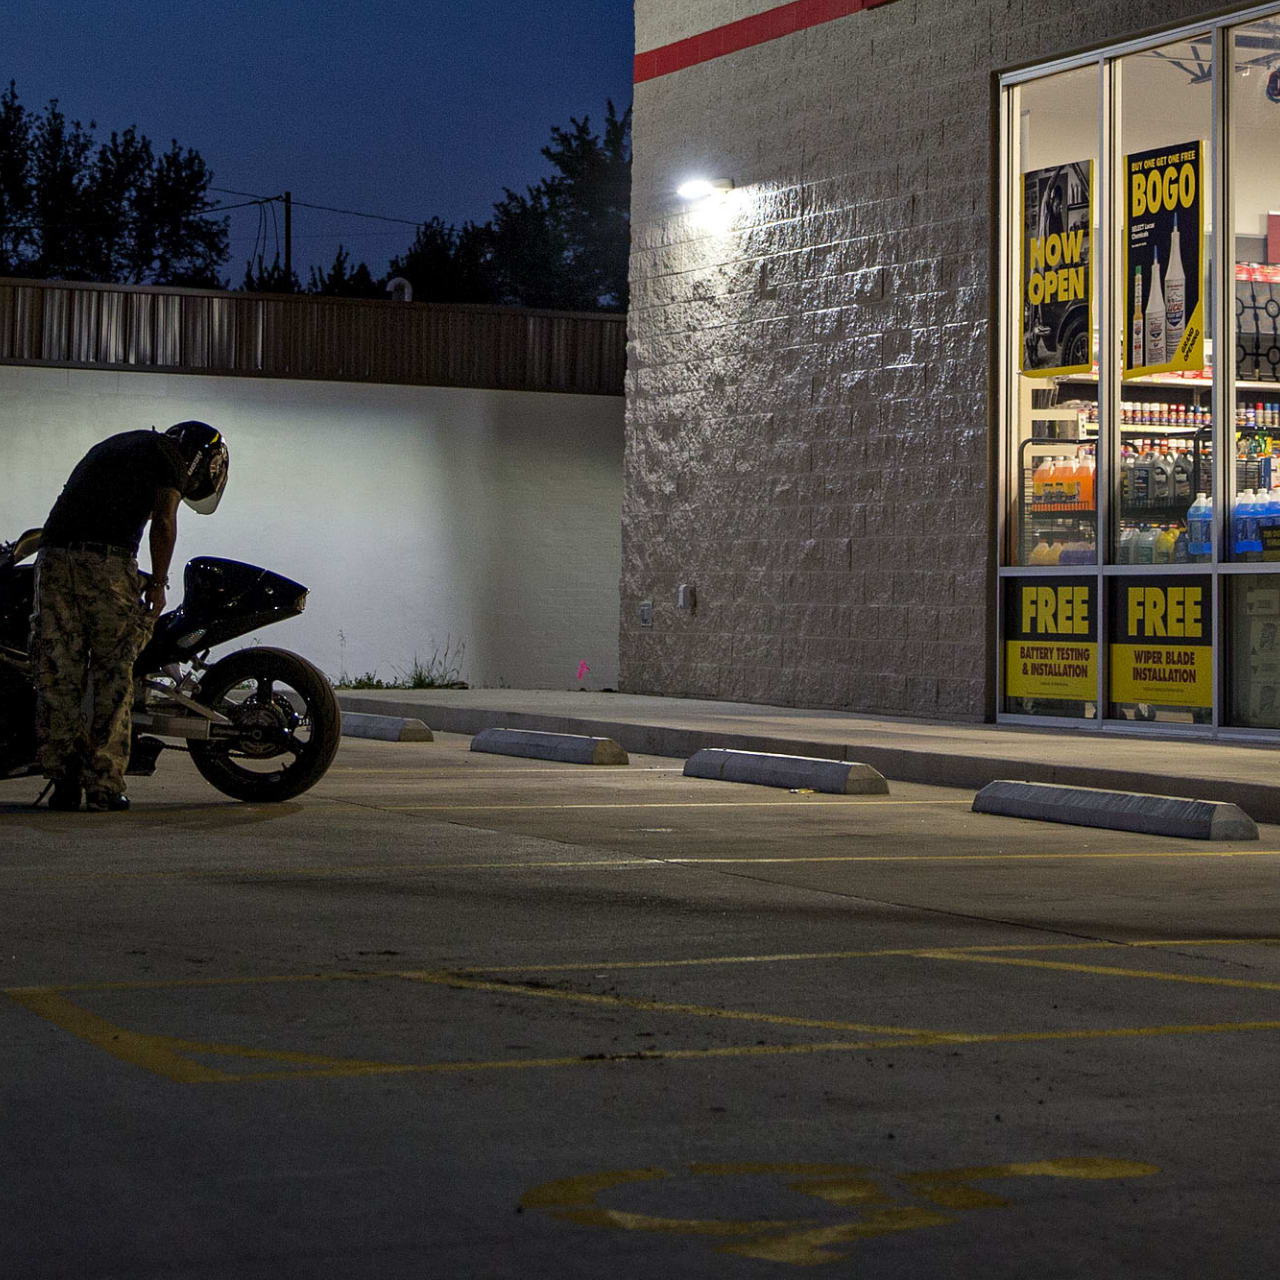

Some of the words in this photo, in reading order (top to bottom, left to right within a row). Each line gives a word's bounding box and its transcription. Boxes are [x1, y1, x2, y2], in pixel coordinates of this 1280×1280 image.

[1131, 161, 1143, 172] BUY
[1143, 158, 1155, 169] ONE
[1156, 156, 1167, 167] GET
[1168, 153, 1180, 164] ONE
[1180, 150, 1196, 162] FREE
[1132, 162, 1196, 218] BOGO
[1030, 229, 1084, 270] NOW
[1028, 266, 1085, 306] OPEN
[1181, 327, 1195, 354] GRAND
[1184, 329, 1201, 362] OPENING
[1022, 586, 1089, 634] FREE
[1128, 587, 1203, 638] FREE
[1020, 646, 1055, 661] BATTERY
[1056, 647, 1090, 662] TESTING
[1134, 650, 1163, 665] WIPER
[1166, 651, 1195, 666] BLADE
[1022, 663, 1028, 675] &
[1031, 663, 1088, 678] INSTALLATION
[1133, 667, 1197, 683] INSTALLATION
